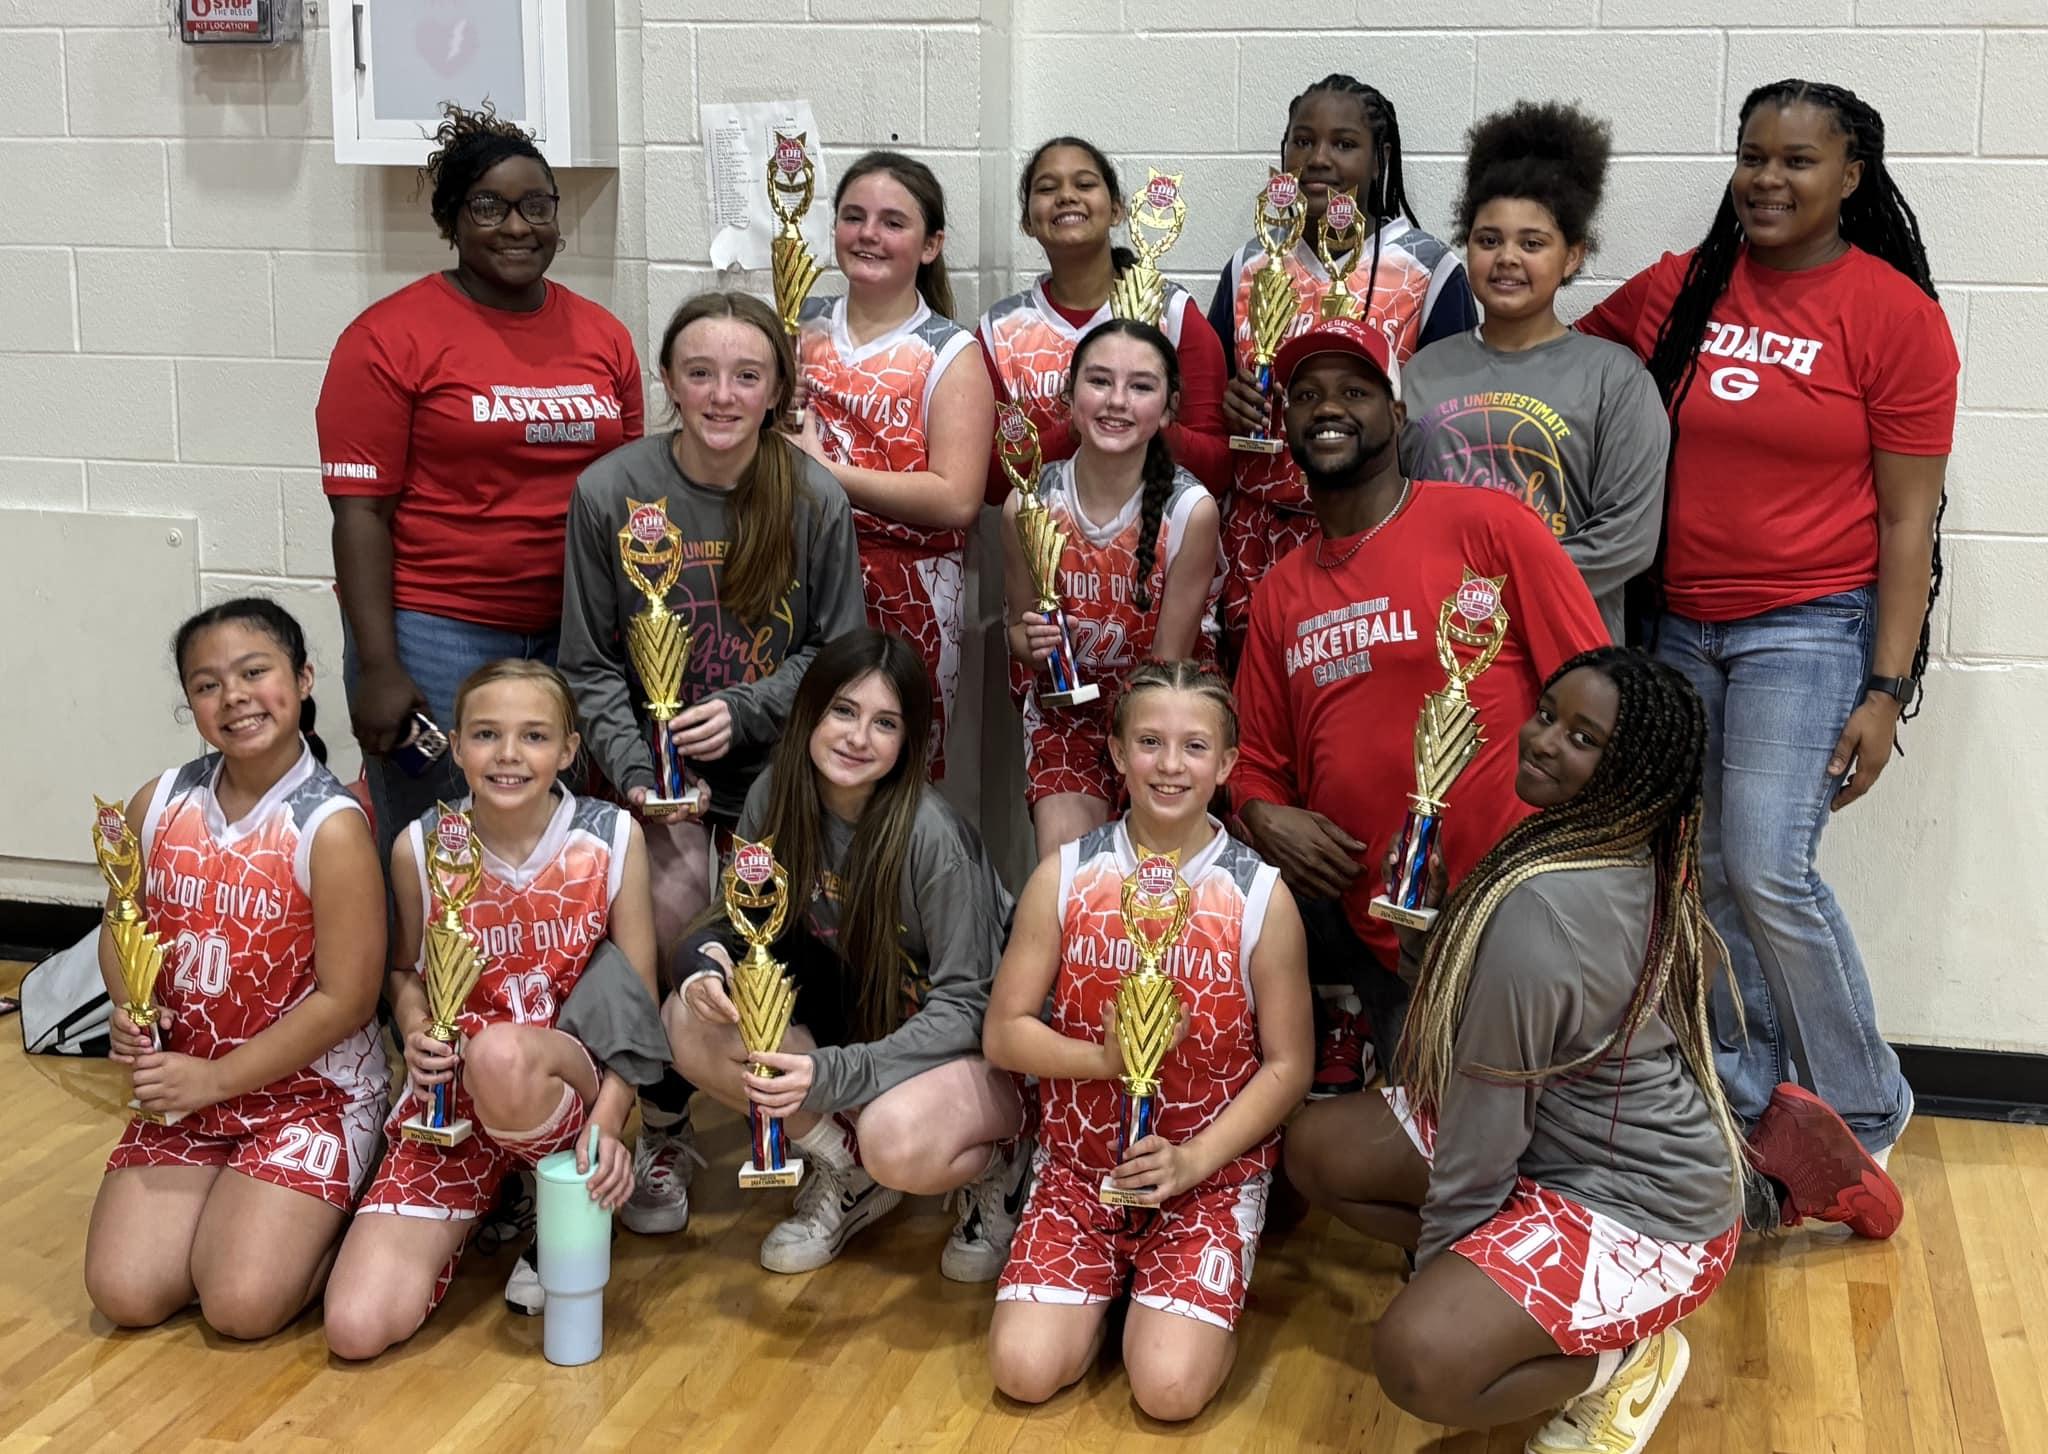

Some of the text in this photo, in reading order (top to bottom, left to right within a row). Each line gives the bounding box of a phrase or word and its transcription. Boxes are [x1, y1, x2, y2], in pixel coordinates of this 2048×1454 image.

[210, 22, 249, 31] LOCATION
[1710, 366, 1760, 401] G
[525, 421, 595, 443] COACH
[1464, 392, 1571, 441] UNDERESTIMATE
[1463, 589, 1494, 604] LDB
[690, 622, 773, 674] Girl
[1075, 618, 1132, 668] 22
[1286, 609, 1418, 681] BASKETBALL
[1312, 650, 1373, 688] COACH
[739, 855, 769, 867] LDB
[1142, 867, 1173, 879] LDB
[215, 881, 281, 920] DIVAS
[532, 910, 602, 951] DIVAS
[173, 930, 230, 998] 20
[268, 1124, 341, 1178] 20
[1199, 1246, 1233, 1296] 0
